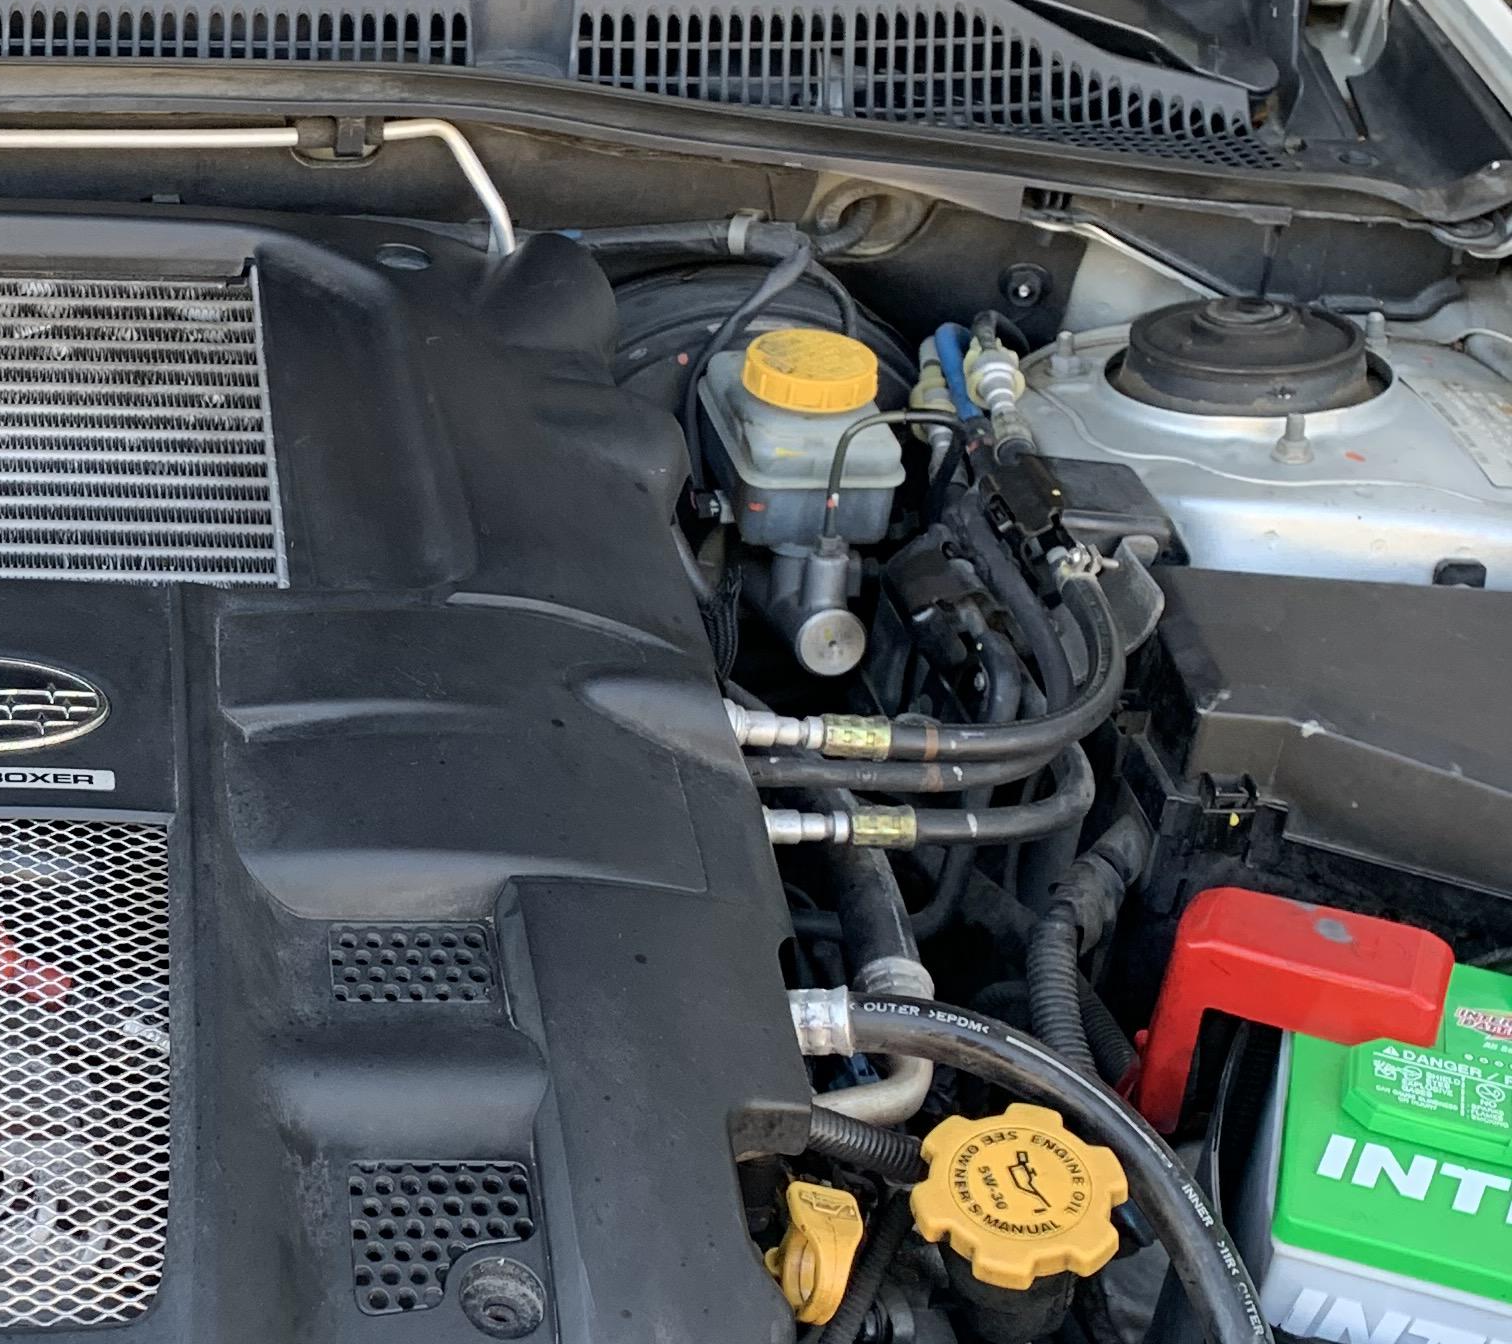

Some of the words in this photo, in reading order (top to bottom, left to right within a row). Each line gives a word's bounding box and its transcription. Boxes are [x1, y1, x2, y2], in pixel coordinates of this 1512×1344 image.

[863, 1001, 921, 1017] OUTER
[1402, 1049, 1483, 1079] DANGER
[981, 1130, 1019, 1146] SEE
[978, 1165, 1008, 1210] 5W-30
[1031, 1134, 1085, 1186] ENGINE
[1064, 1191, 1086, 1214] OIL
[1316, 1133, 1512, 1225] INT
[983, 1214, 1061, 1235] MANUAL
[1181, 1183, 1215, 1229] INNER
